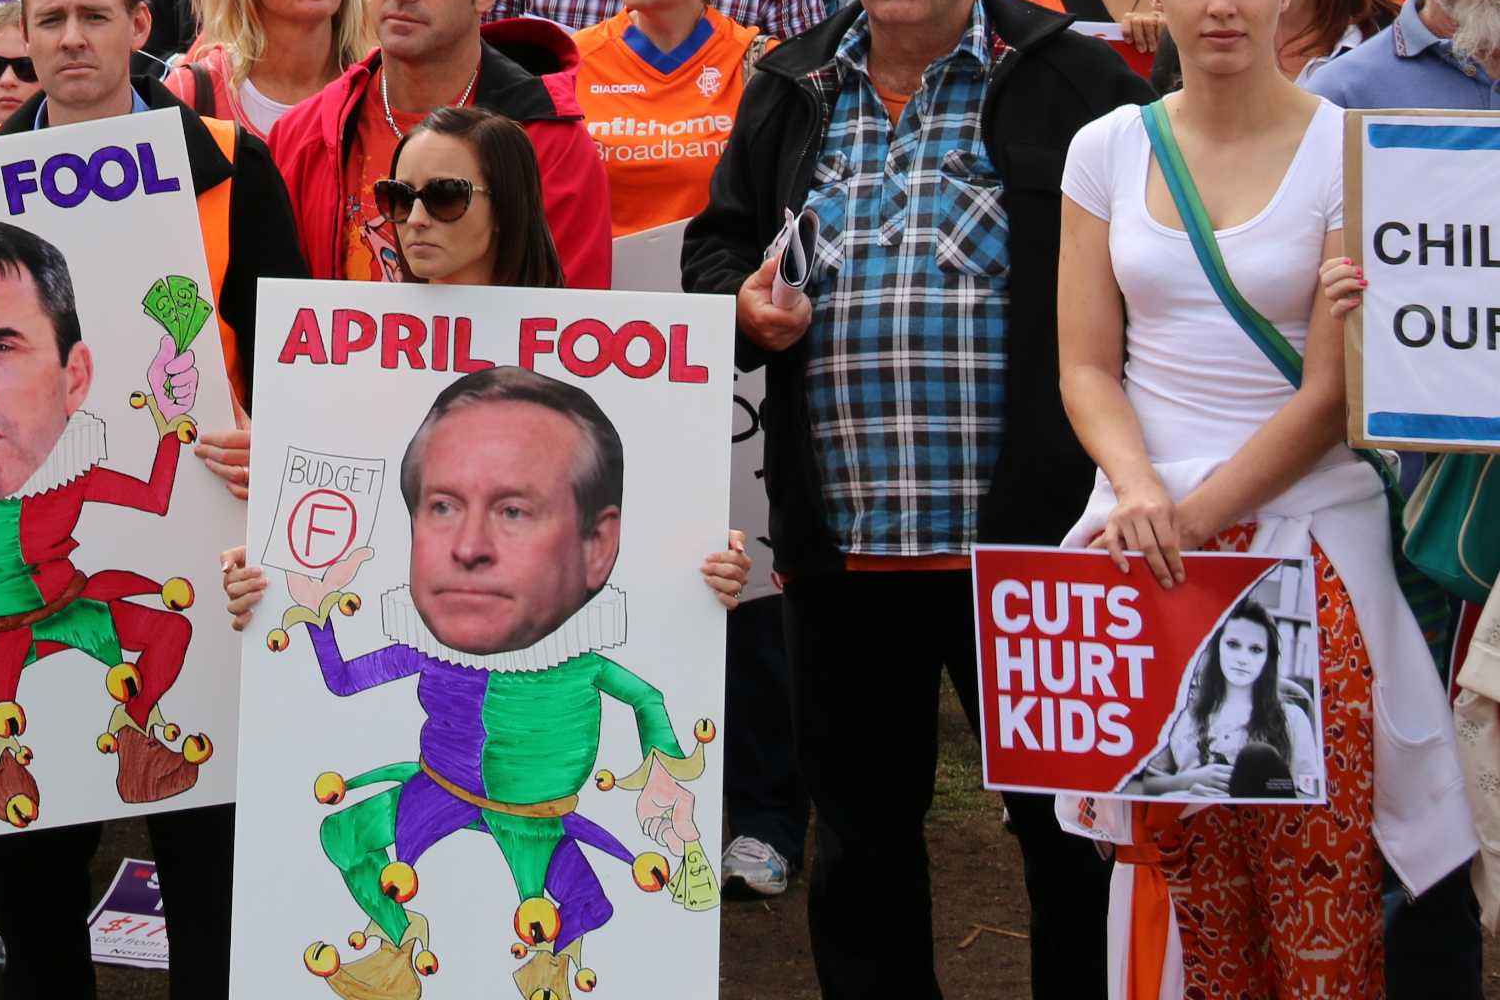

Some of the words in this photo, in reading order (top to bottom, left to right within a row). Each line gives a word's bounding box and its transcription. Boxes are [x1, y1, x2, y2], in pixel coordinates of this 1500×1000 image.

[590, 83, 646, 94] DIADORA
[587, 115, 733, 137] ntl:home
[0, 142, 181, 216] FOOL
[278, 308, 495, 374] APRIL
[519, 317, 709, 384] FOOL
[289, 455, 381, 496] BUDGET
[306, 504, 348, 557] F
[991, 579, 1142, 640] CUTS
[995, 636, 1155, 699] HURT
[998, 695, 1134, 757] KIDS
